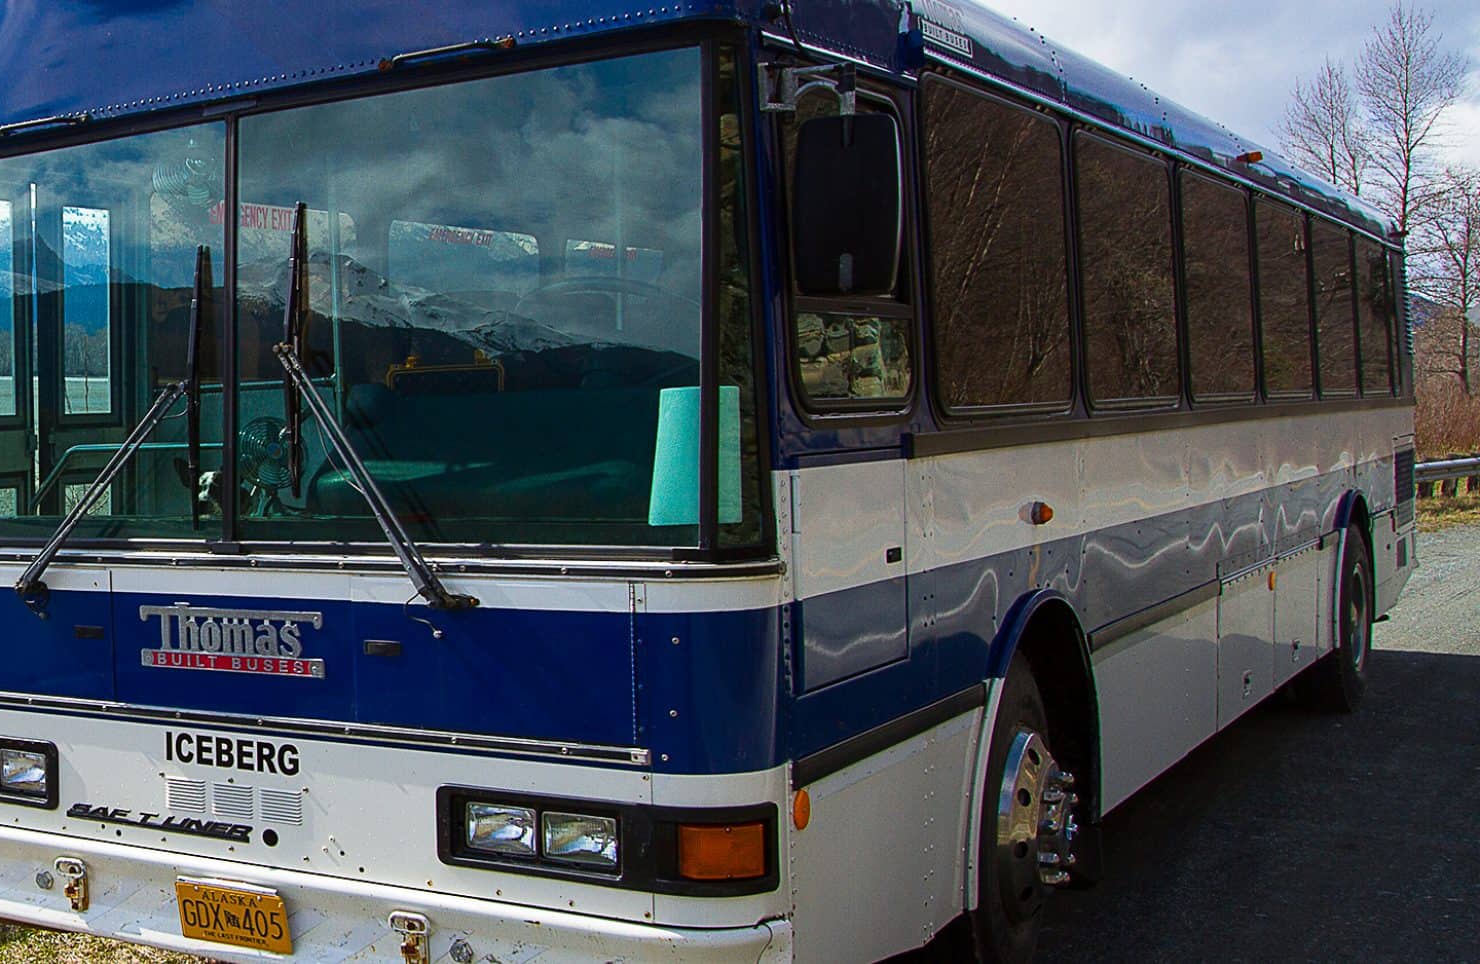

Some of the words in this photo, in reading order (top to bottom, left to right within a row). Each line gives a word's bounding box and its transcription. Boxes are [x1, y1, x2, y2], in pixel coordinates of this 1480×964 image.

[272, 207, 293, 231] EXIT
[140, 601, 322, 659] Thomas
[157, 652, 217, 669] BUILT
[231, 656, 305, 674] BUSES
[166, 731, 300, 776] ICEBERG
[201, 891, 258, 908] ALASKA
[183, 898, 225, 931] GDX
[242, 908, 283, 940] 405
